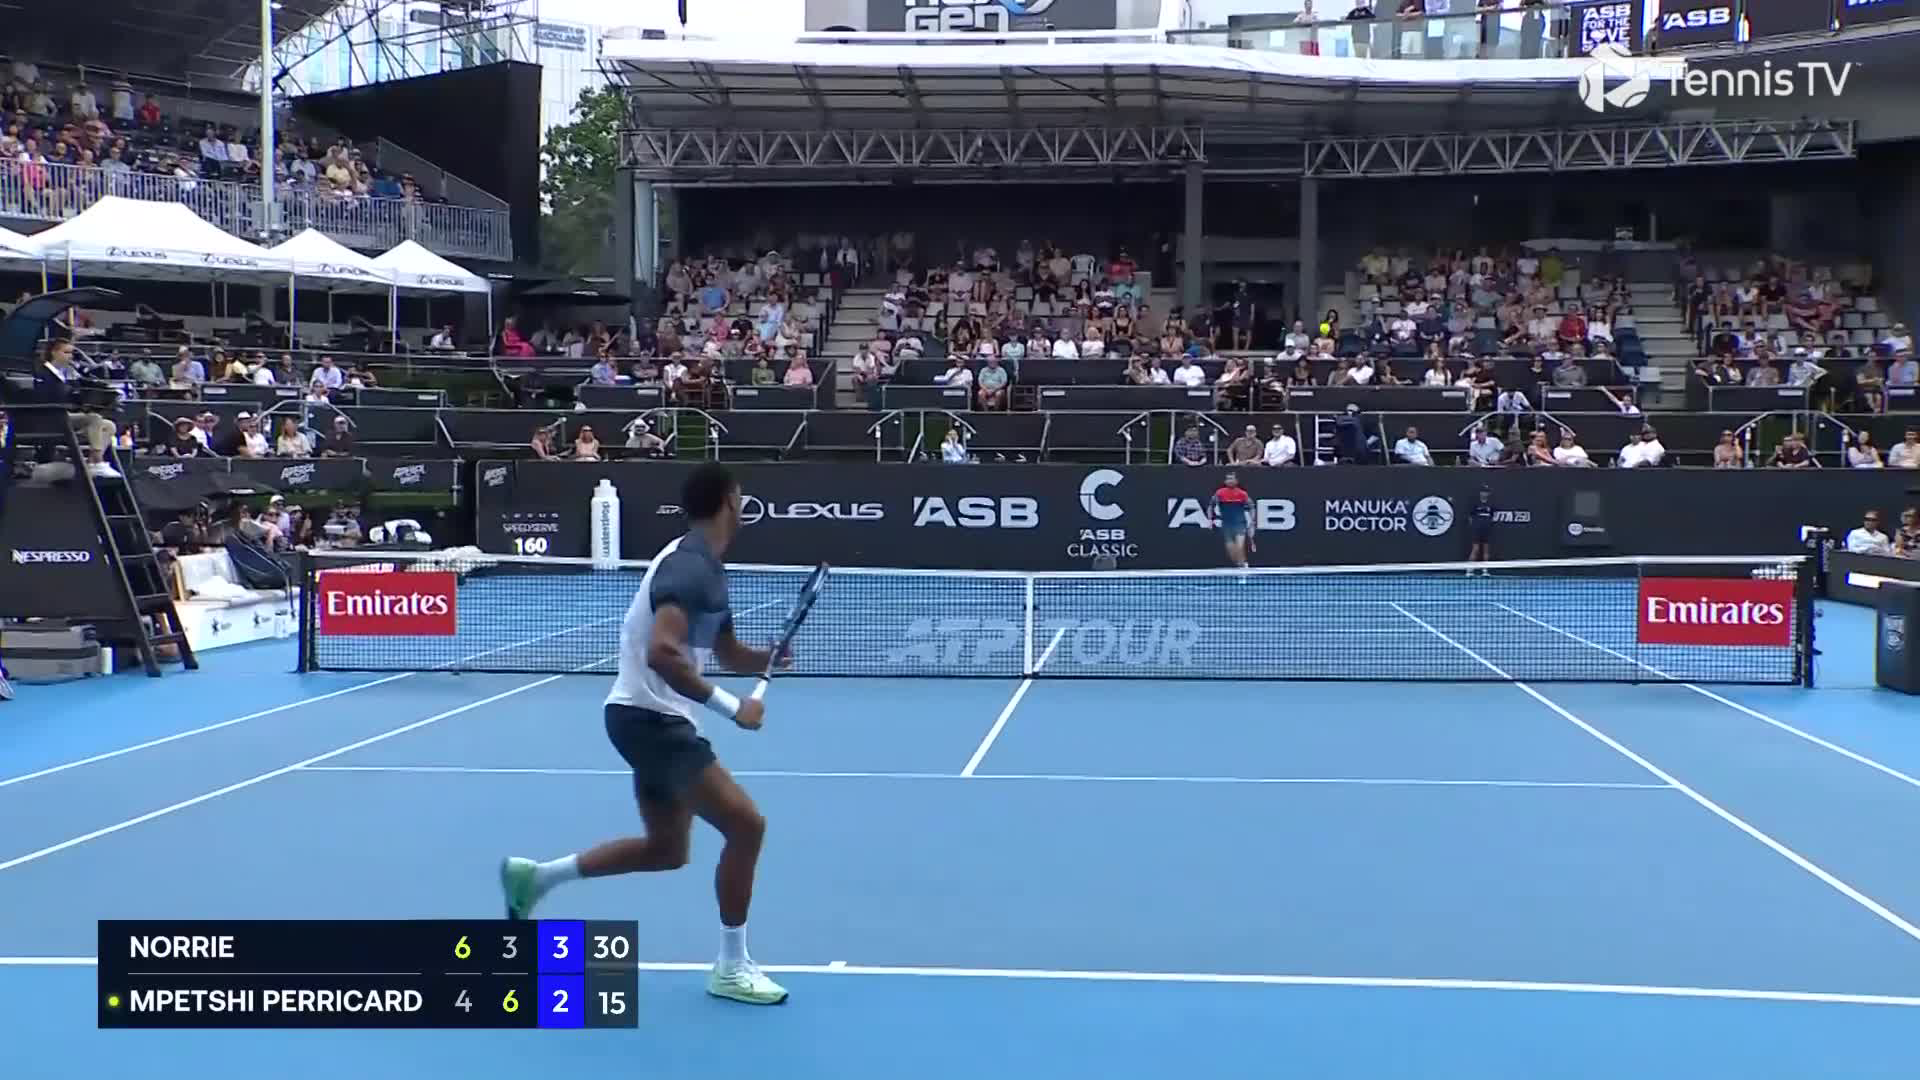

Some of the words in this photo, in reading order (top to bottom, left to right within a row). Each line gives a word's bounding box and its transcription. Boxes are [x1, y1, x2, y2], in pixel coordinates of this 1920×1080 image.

[1583, 4, 1631, 20] ASB
[1663, 7, 1731, 30] ASB
[1583, 20, 1606, 30] FOR
[1608, 17, 1631, 28] THE
[768, 502, 884, 519] LEXUS
[913, 496, 1040, 528] ASB
[1167, 498, 1296, 531] AB
[1325, 500, 1408, 514] MANUKA
[1325, 516, 1407, 531] DOCTOR
[1079, 529, 1126, 541] ASB
[514, 537, 548, 554] 160
[1067, 543, 1138, 558] CLASSIC
[11, 549, 91, 564] NESPRESSO
[327, 589, 448, 616] Emirates
[1647, 596, 1784, 625] Emirates
[887, 617, 1022, 664] ATP
[1036, 617, 1202, 664] TOUR
